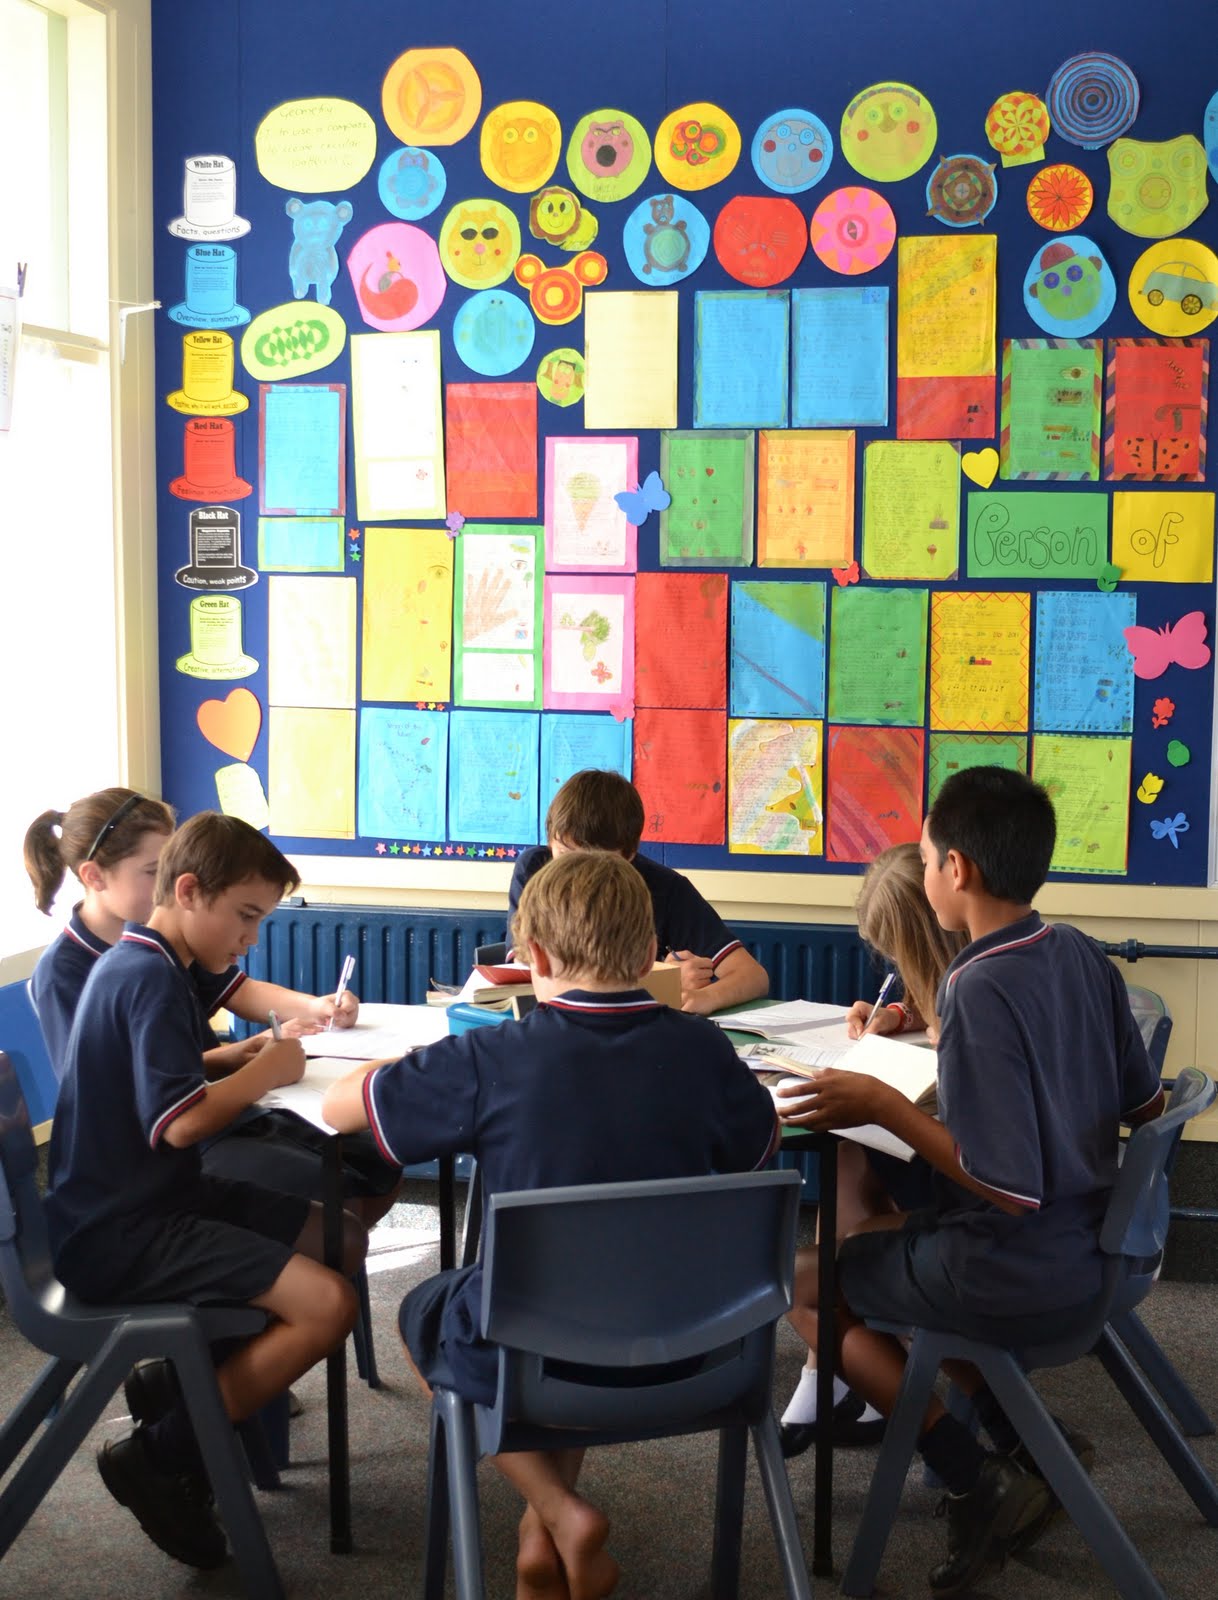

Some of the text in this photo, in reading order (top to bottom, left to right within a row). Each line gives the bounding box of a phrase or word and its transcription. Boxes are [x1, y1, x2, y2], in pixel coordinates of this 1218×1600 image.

[194, 160, 224, 169] White Hat
[202, 225, 241, 236] questions
[195, 248, 225, 257] Blue Hat
[192, 335, 223, 344] Yellow Hat
[193, 422, 224, 430] Red Hat
[198, 511, 229, 520] Black Hat
[973, 502, 1098, 570] Person
[1130, 511, 1184, 569] of
[209, 577, 226, 585] weak
[226, 575, 247, 586] points
[199, 600, 230, 608] Green Hat
